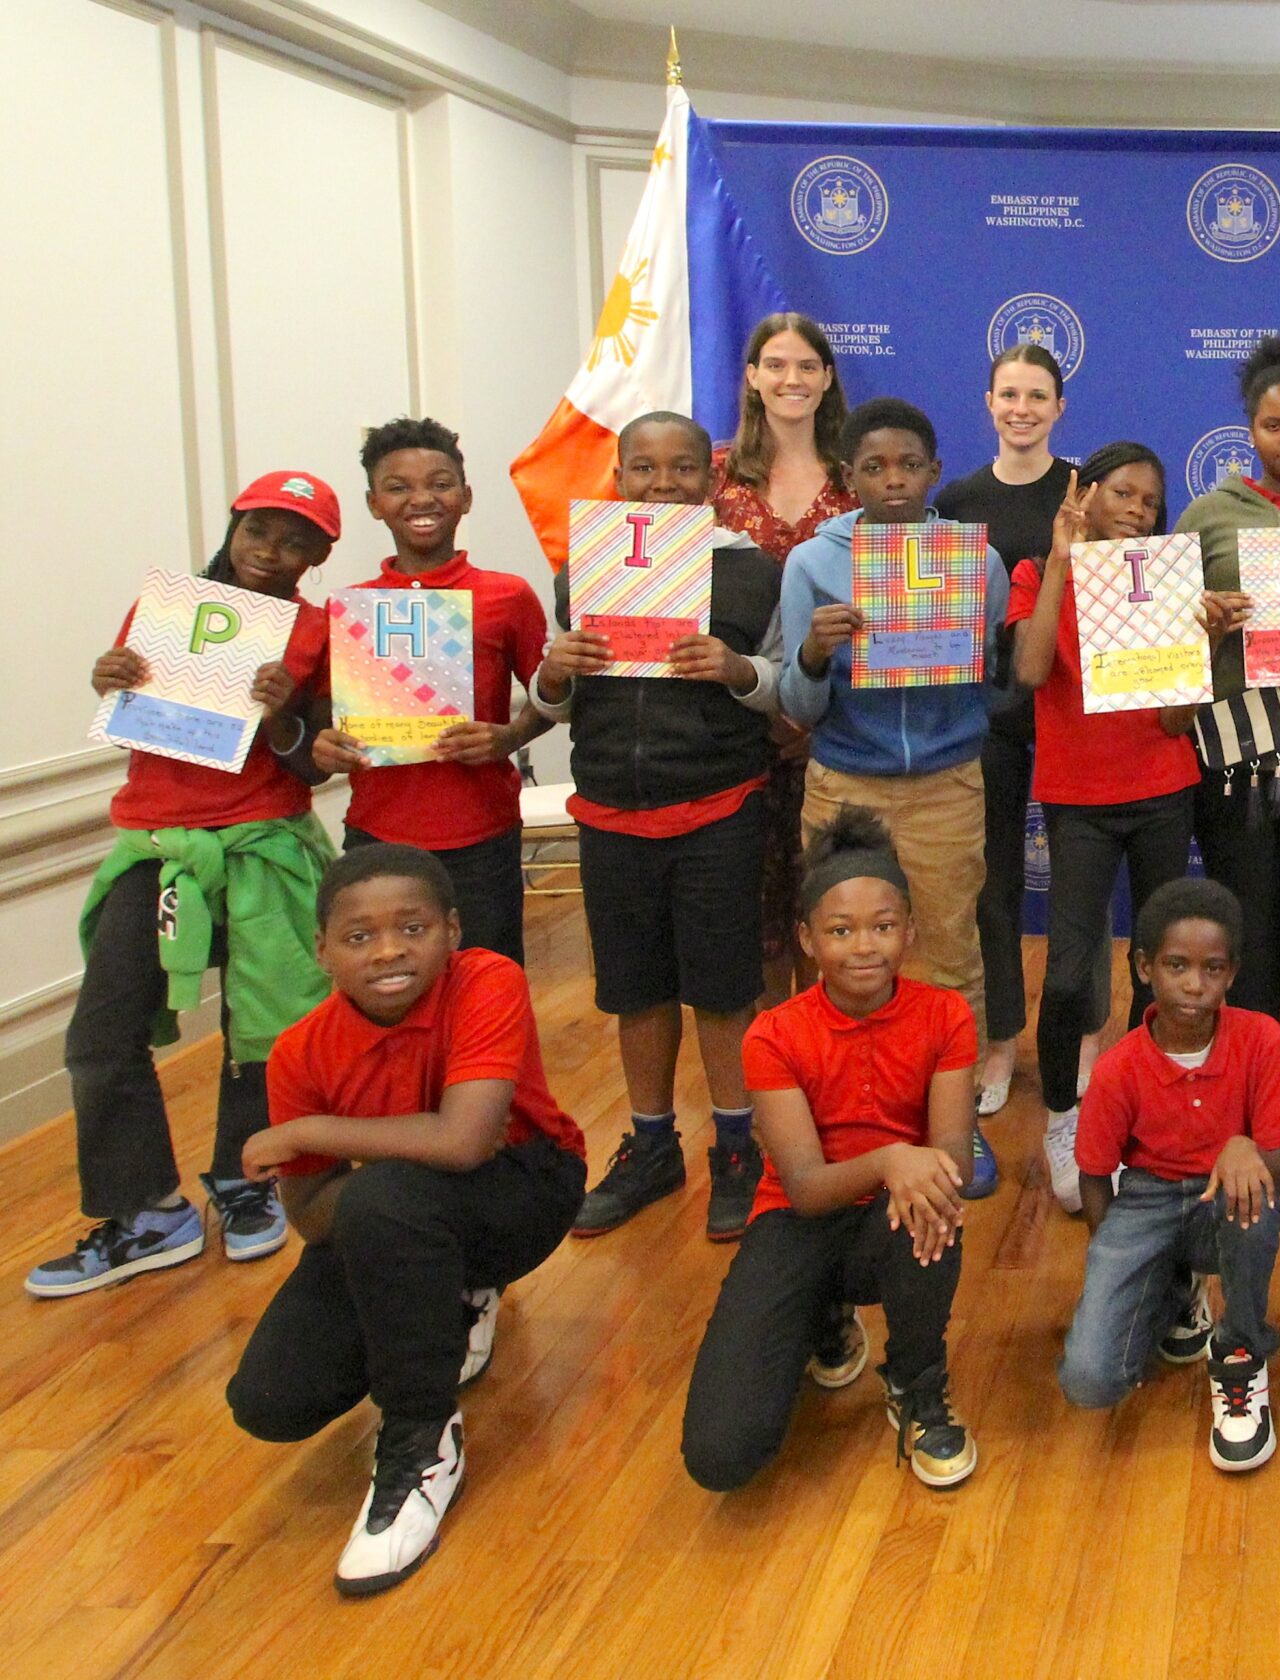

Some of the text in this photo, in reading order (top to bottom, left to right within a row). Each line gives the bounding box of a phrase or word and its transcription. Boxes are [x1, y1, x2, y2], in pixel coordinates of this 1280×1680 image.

[991, 195, 1079, 206] EMBASSY OF THE
[1003, 206, 1070, 216] PHILIPPINES
[985, 216, 1085, 229] WASHINGTON, D.C.
[819, 323, 890, 334] BASSY OF THE
[1190, 329, 1238, 338] EMBASSY
[1240, 329, 1254, 338] OF
[826, 334, 880, 344] ILIPPINES
[832, 345, 896, 356] NGTON, D.C.
[1185, 350, 1250, 359] WASHINGTO
[625, 513, 654, 568] I
[907, 537, 942, 590] L
[1124, 549, 1153, 603] I
[189, 602, 242, 654] P
[376, 601, 426, 658] H
